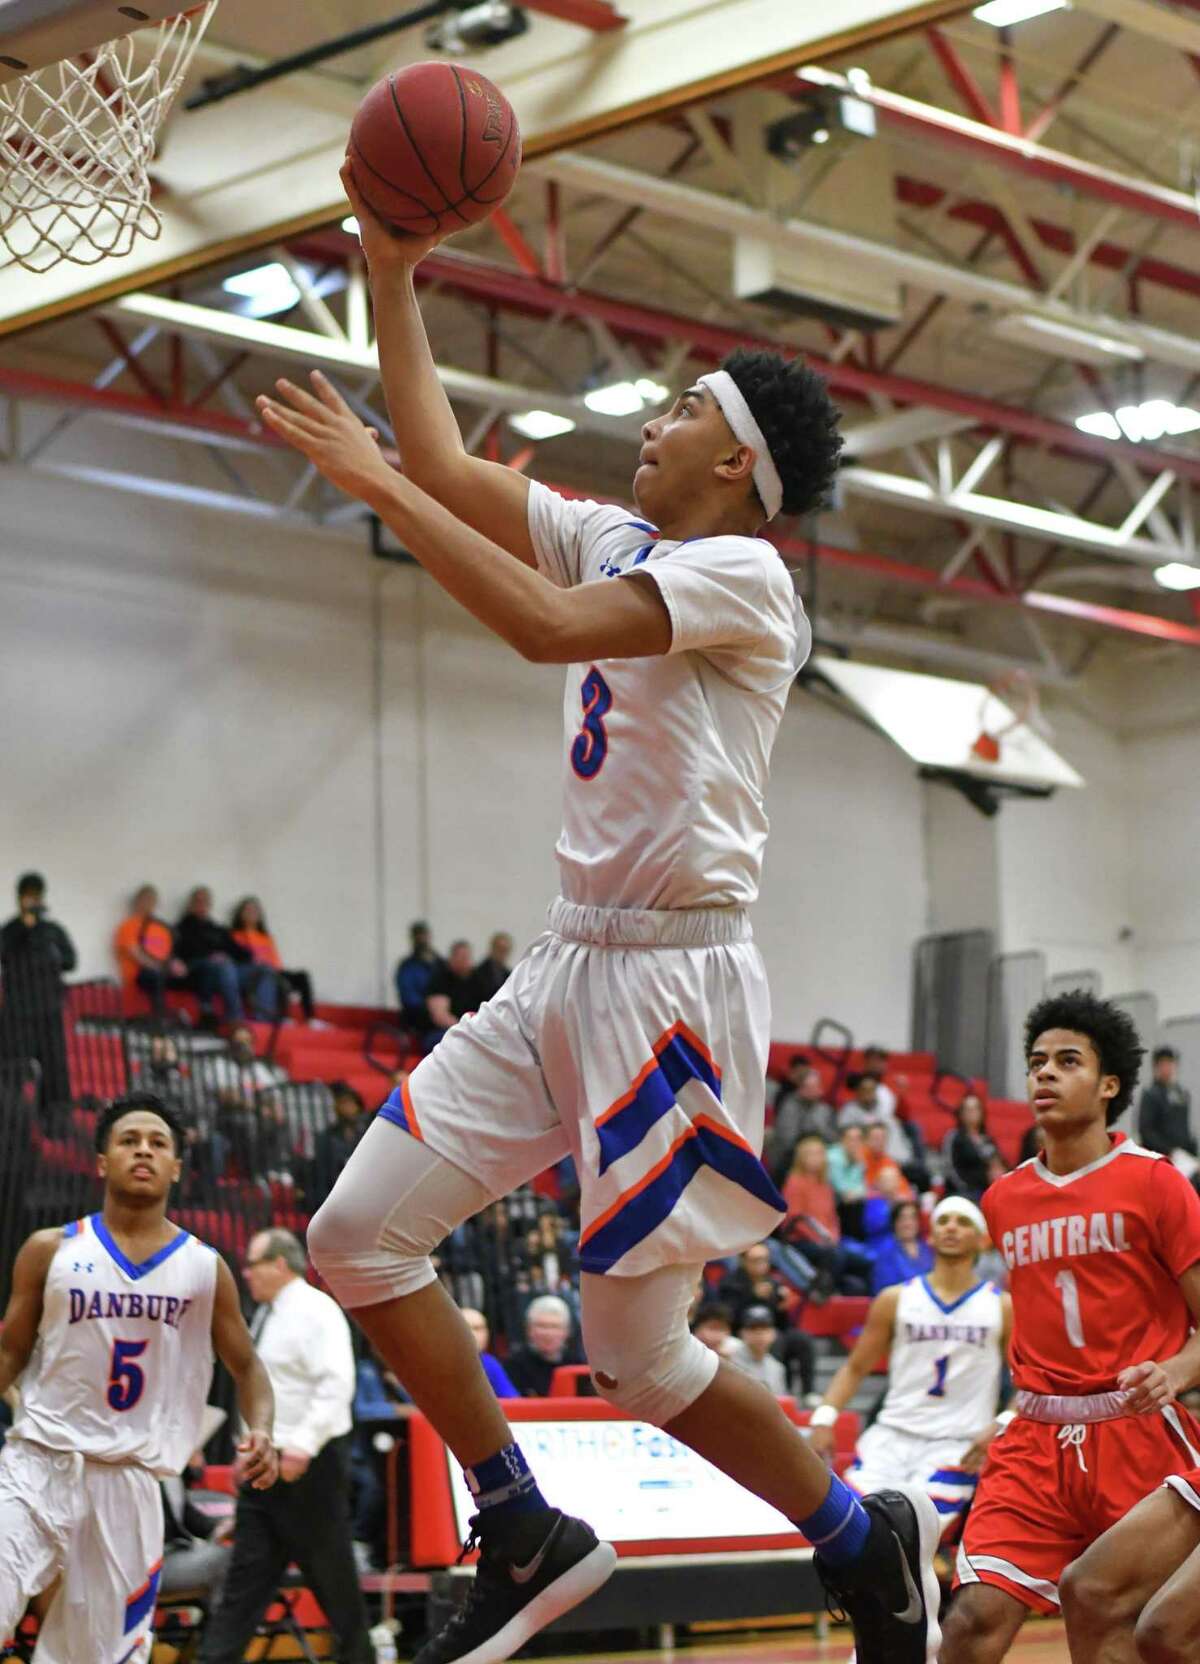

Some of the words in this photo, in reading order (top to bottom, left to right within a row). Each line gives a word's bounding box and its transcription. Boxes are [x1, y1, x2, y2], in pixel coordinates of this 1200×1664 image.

[570, 664, 613, 782] 3
[1002, 1211, 1131, 1271] CENTRAL
[1055, 1268, 1086, 1349] 1
[105, 1338, 150, 1413] 5
[927, 1354, 951, 1397] 1
